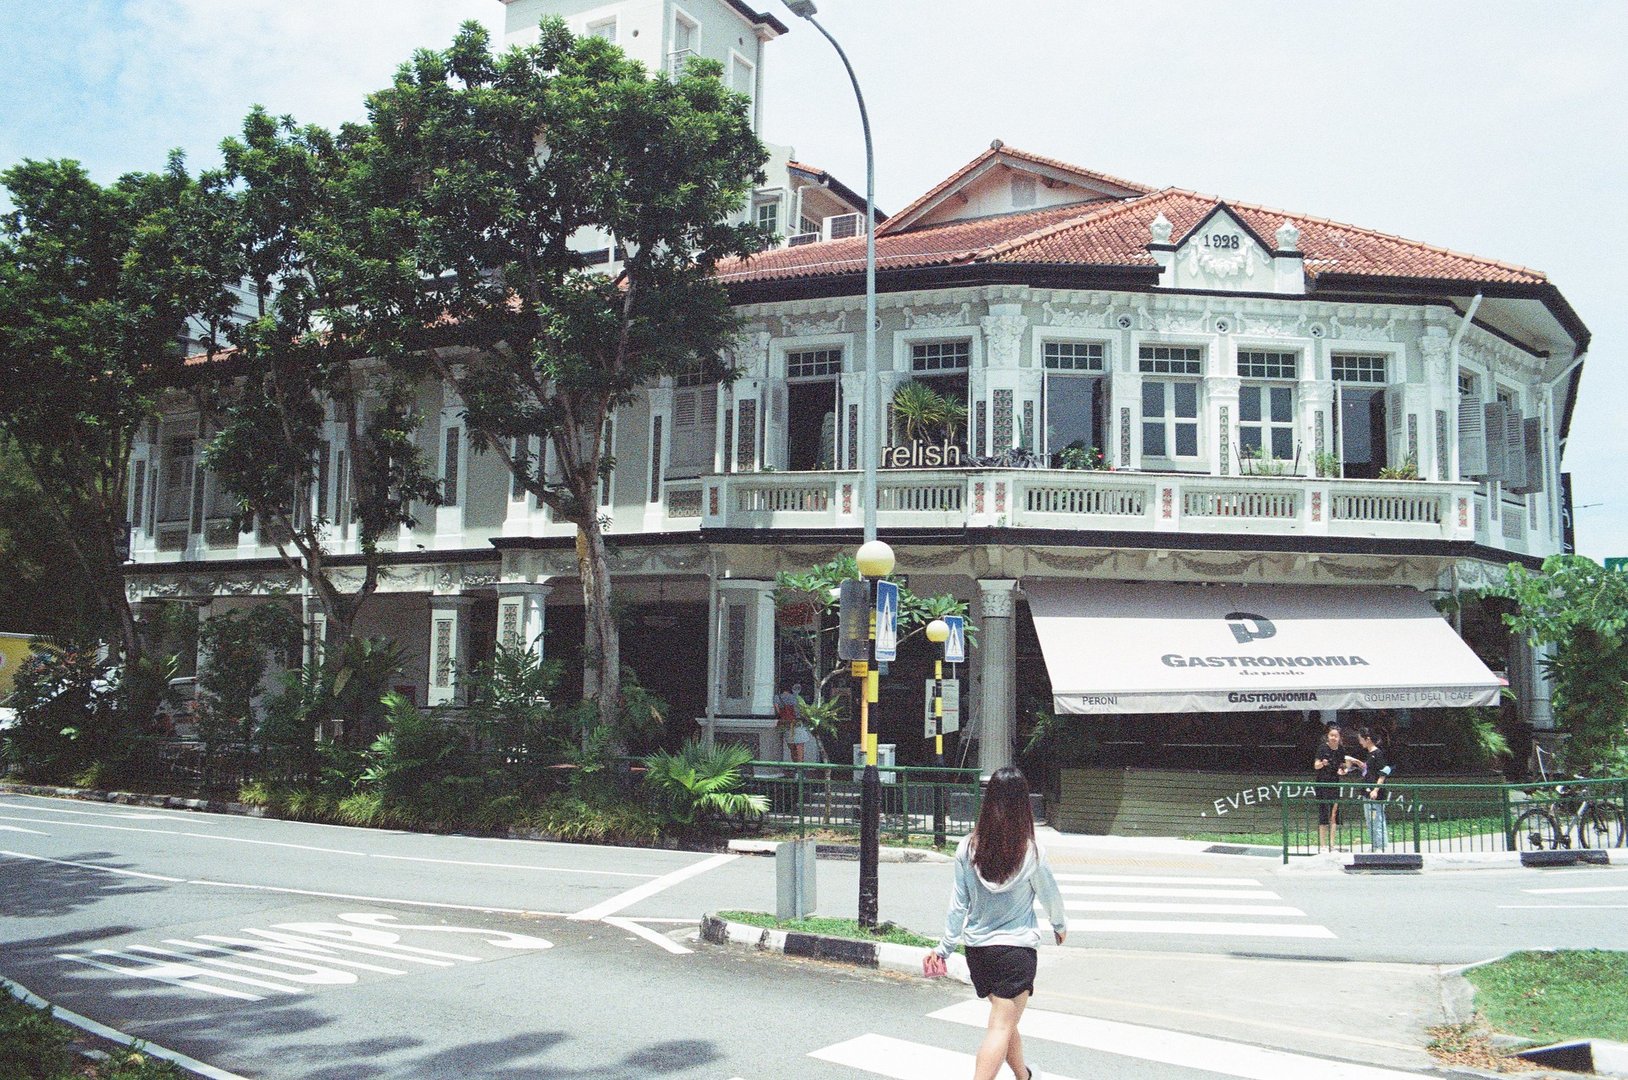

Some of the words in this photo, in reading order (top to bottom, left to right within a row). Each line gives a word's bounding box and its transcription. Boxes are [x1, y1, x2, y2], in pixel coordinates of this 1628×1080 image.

[1204, 234, 1240, 250] 1928
[881, 438, 961, 467] relish
[1160, 653, 1370, 668] GASTRONOMIA
[1082, 695, 1118, 706] PERONI
[1227, 692, 1318, 703] GASTRONOMIA
[1364, 693, 1411, 702] GOURMET
[1213, 784, 1318, 816] EVERYDA
